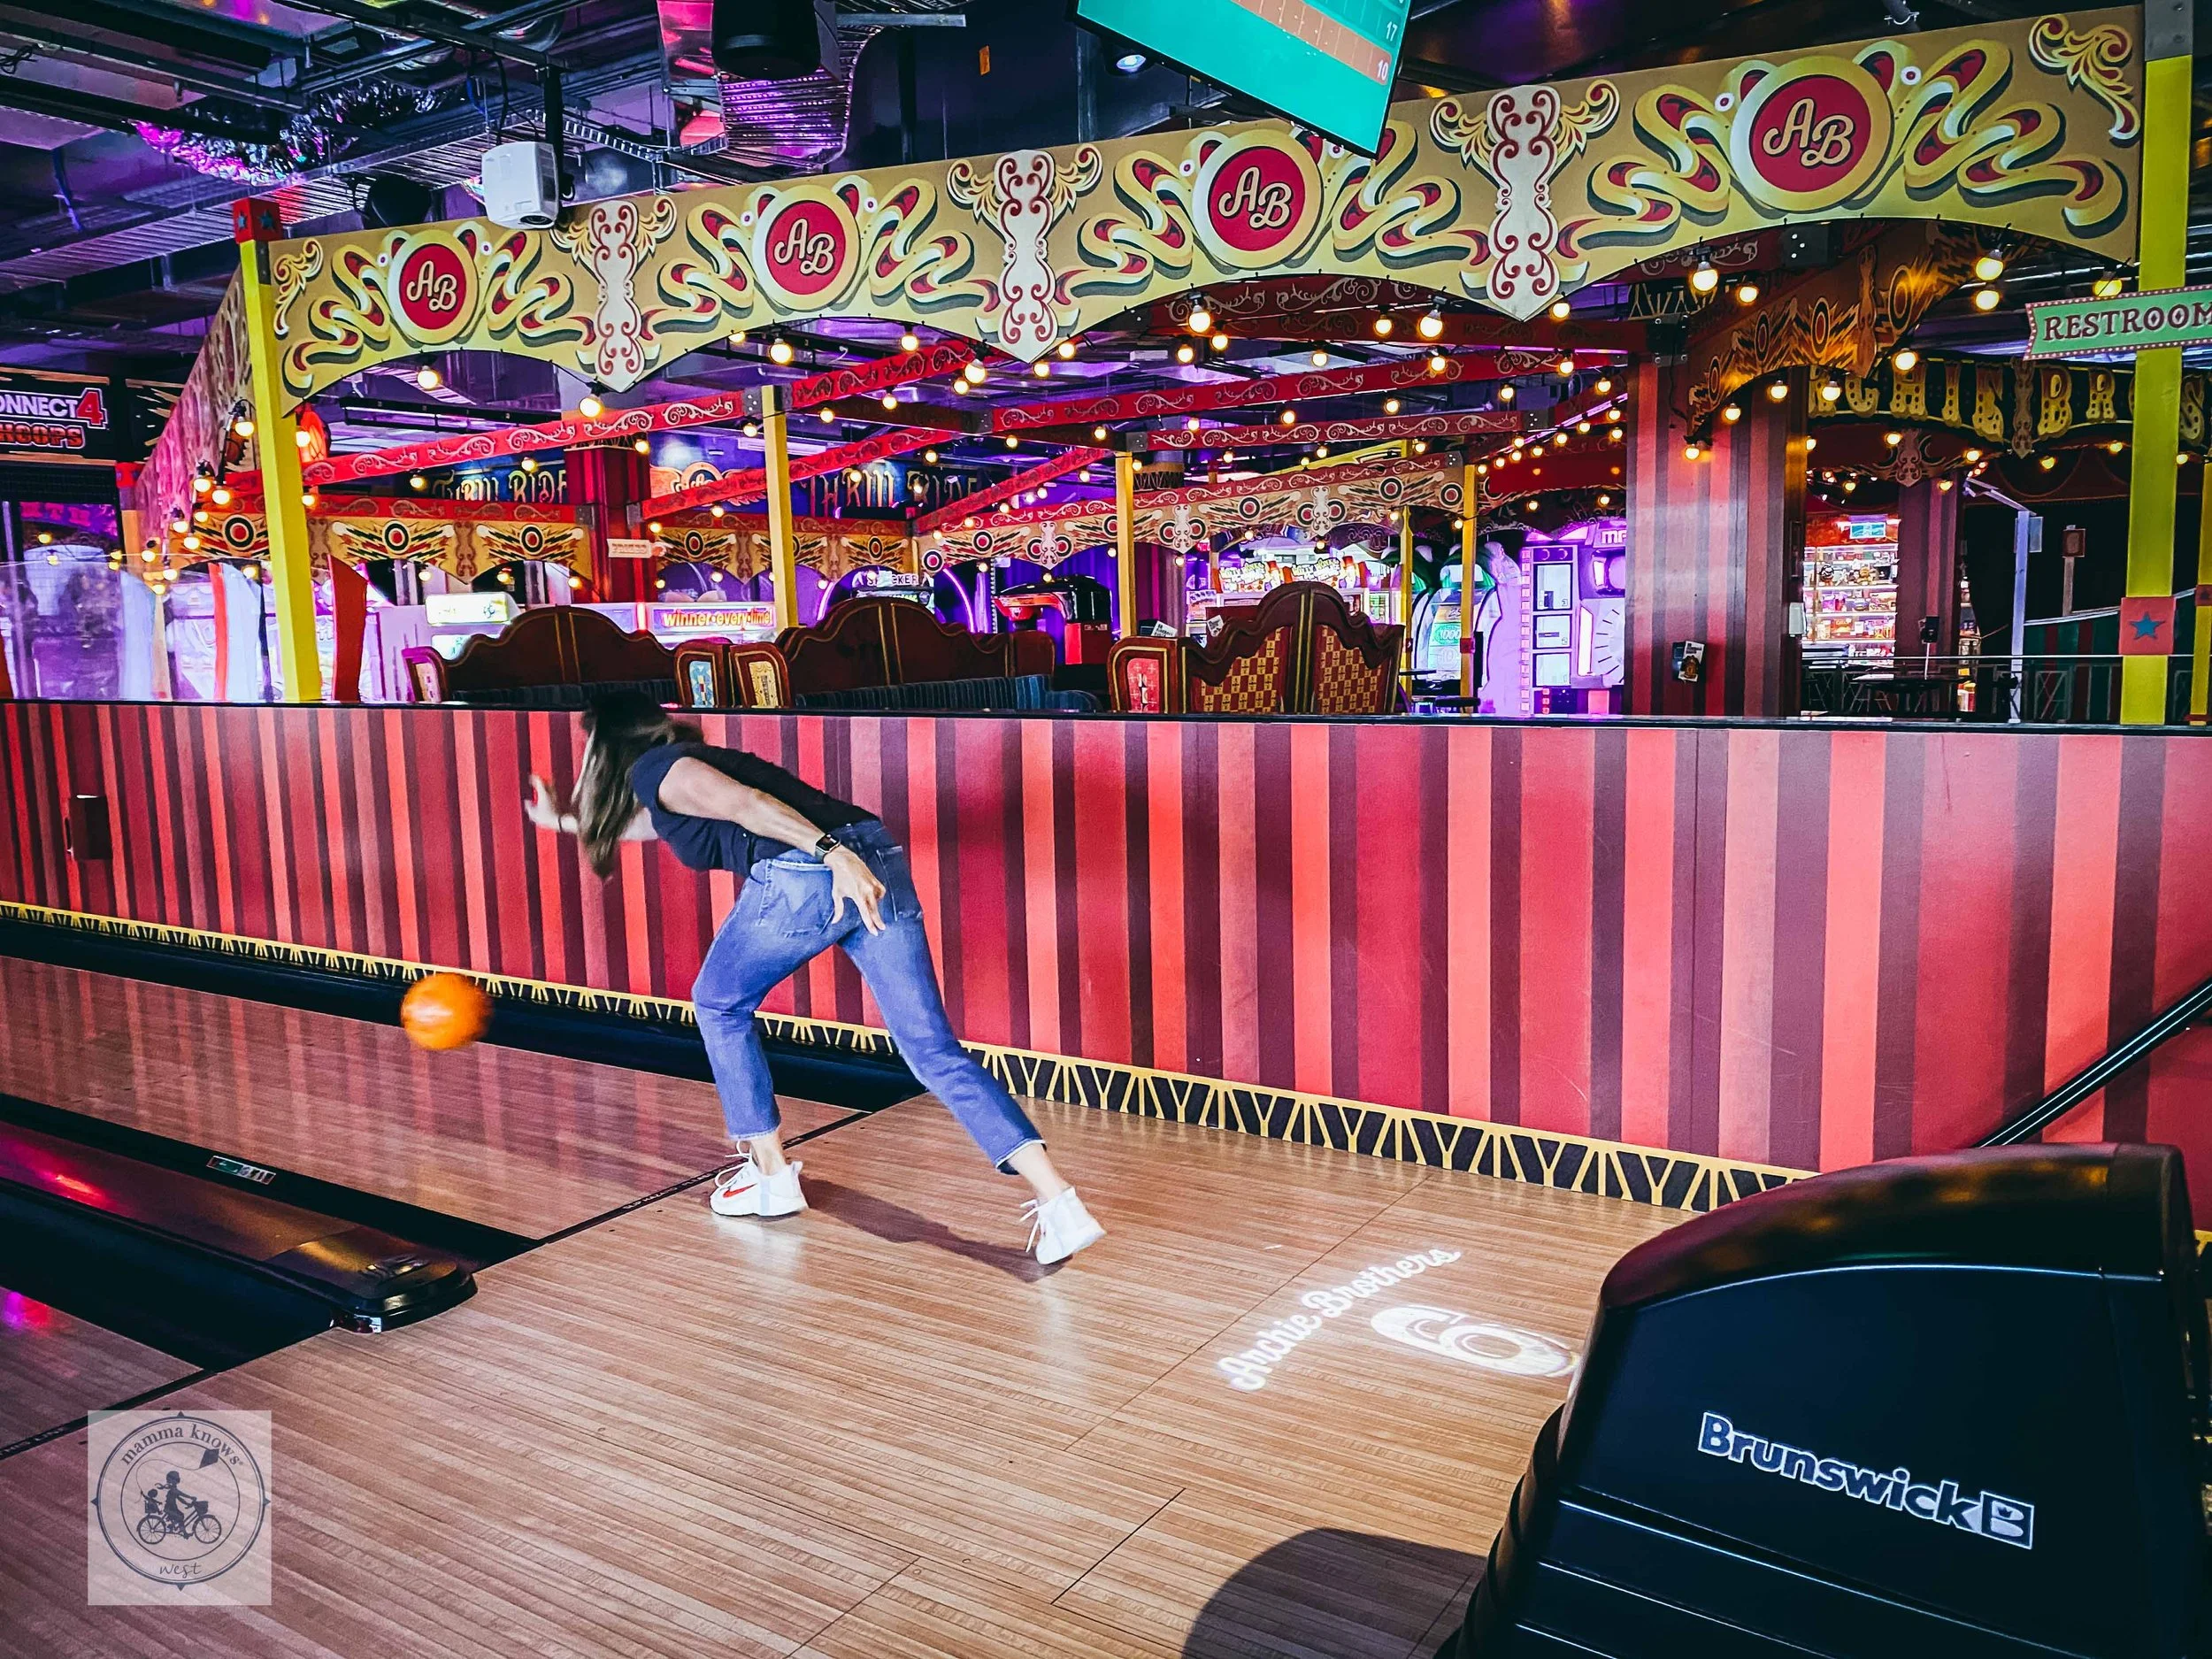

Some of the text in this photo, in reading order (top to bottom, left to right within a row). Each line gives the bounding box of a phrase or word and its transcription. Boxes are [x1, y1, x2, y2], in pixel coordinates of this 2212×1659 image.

[1386, 21, 1398, 42] 17
[1377, 59, 1389, 81] 10
[1763, 98, 1855, 167] AB
[1219, 166, 1292, 229] AB
[774, 219, 836, 276] AB
[406, 259, 458, 312] AB
[2043, 301, 2212, 342] RESTROOM
[77, 390, 104, 426] 4
[2037, 365, 2205, 442] BRS
[0, 422, 85, 449] HOOPS
[1217, 1248, 1462, 1392] Archie Brothers
[1371, 1303, 1581, 1379] 6
[1698, 1411, 1983, 1534] Brunswick
